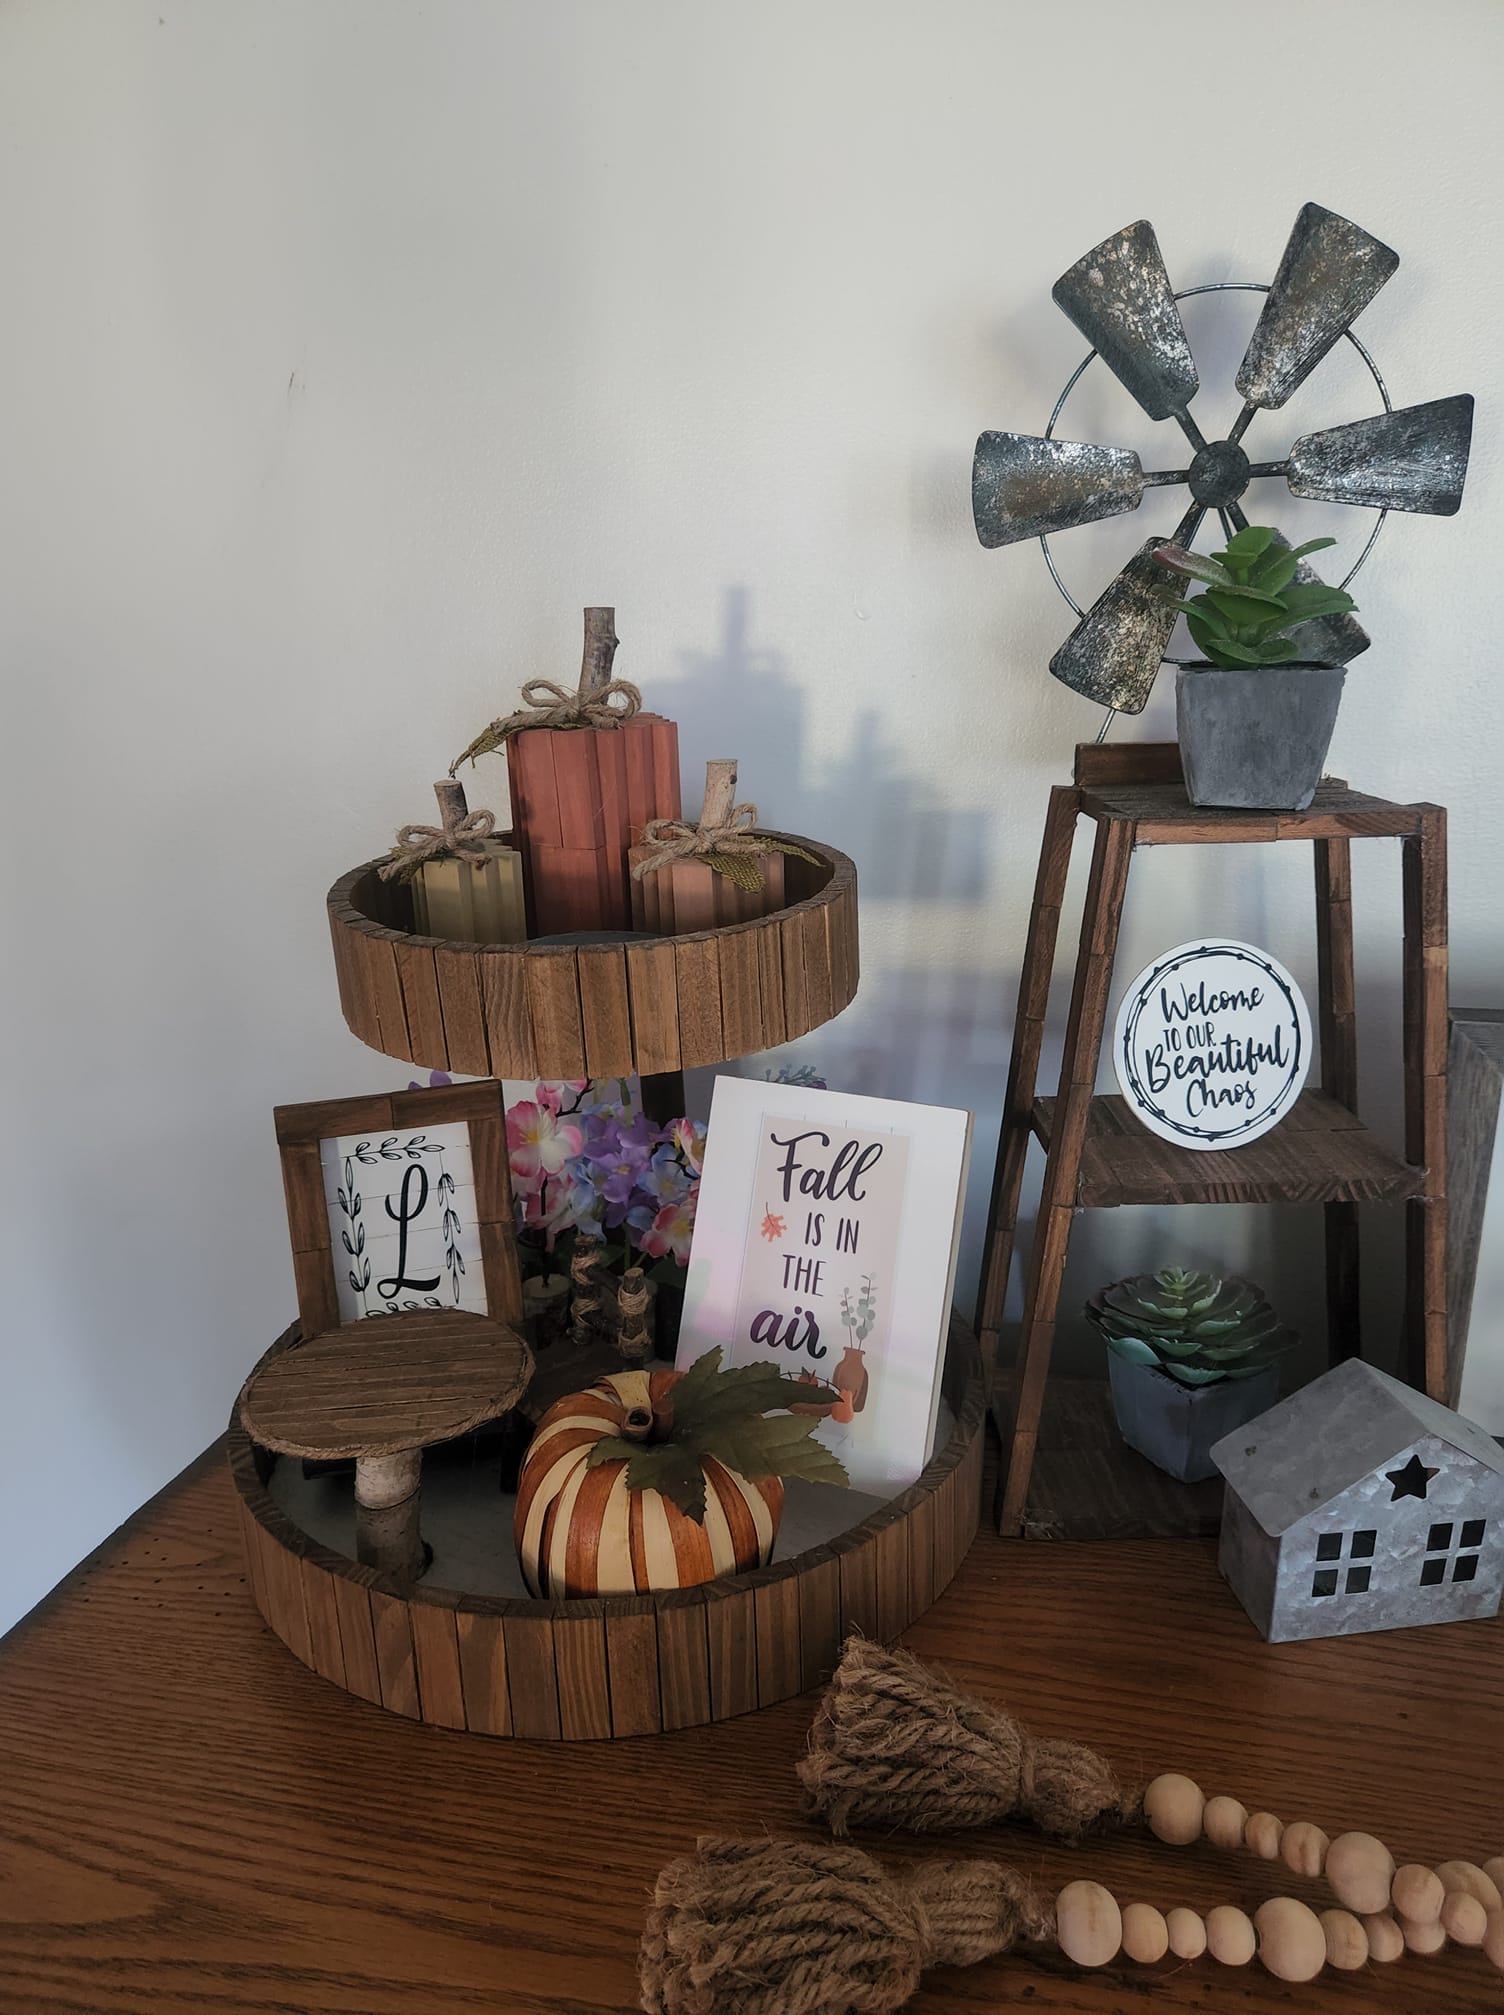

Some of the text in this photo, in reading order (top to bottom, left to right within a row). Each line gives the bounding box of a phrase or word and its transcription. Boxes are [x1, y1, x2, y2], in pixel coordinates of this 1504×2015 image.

[1161, 981, 1264, 1023] Welcome
[1145, 1024, 1289, 1093] Beautiful
[1163, 1022, 1217, 1052] TO OUR
[1187, 1079, 1257, 1117] Chaos
[770, 1131, 883, 1202] Fall
[377, 1163, 441, 1299] L
[805, 1212, 859, 1254] IS IN
[782, 1254, 827, 1297] THE
[750, 1306, 827, 1359] air
